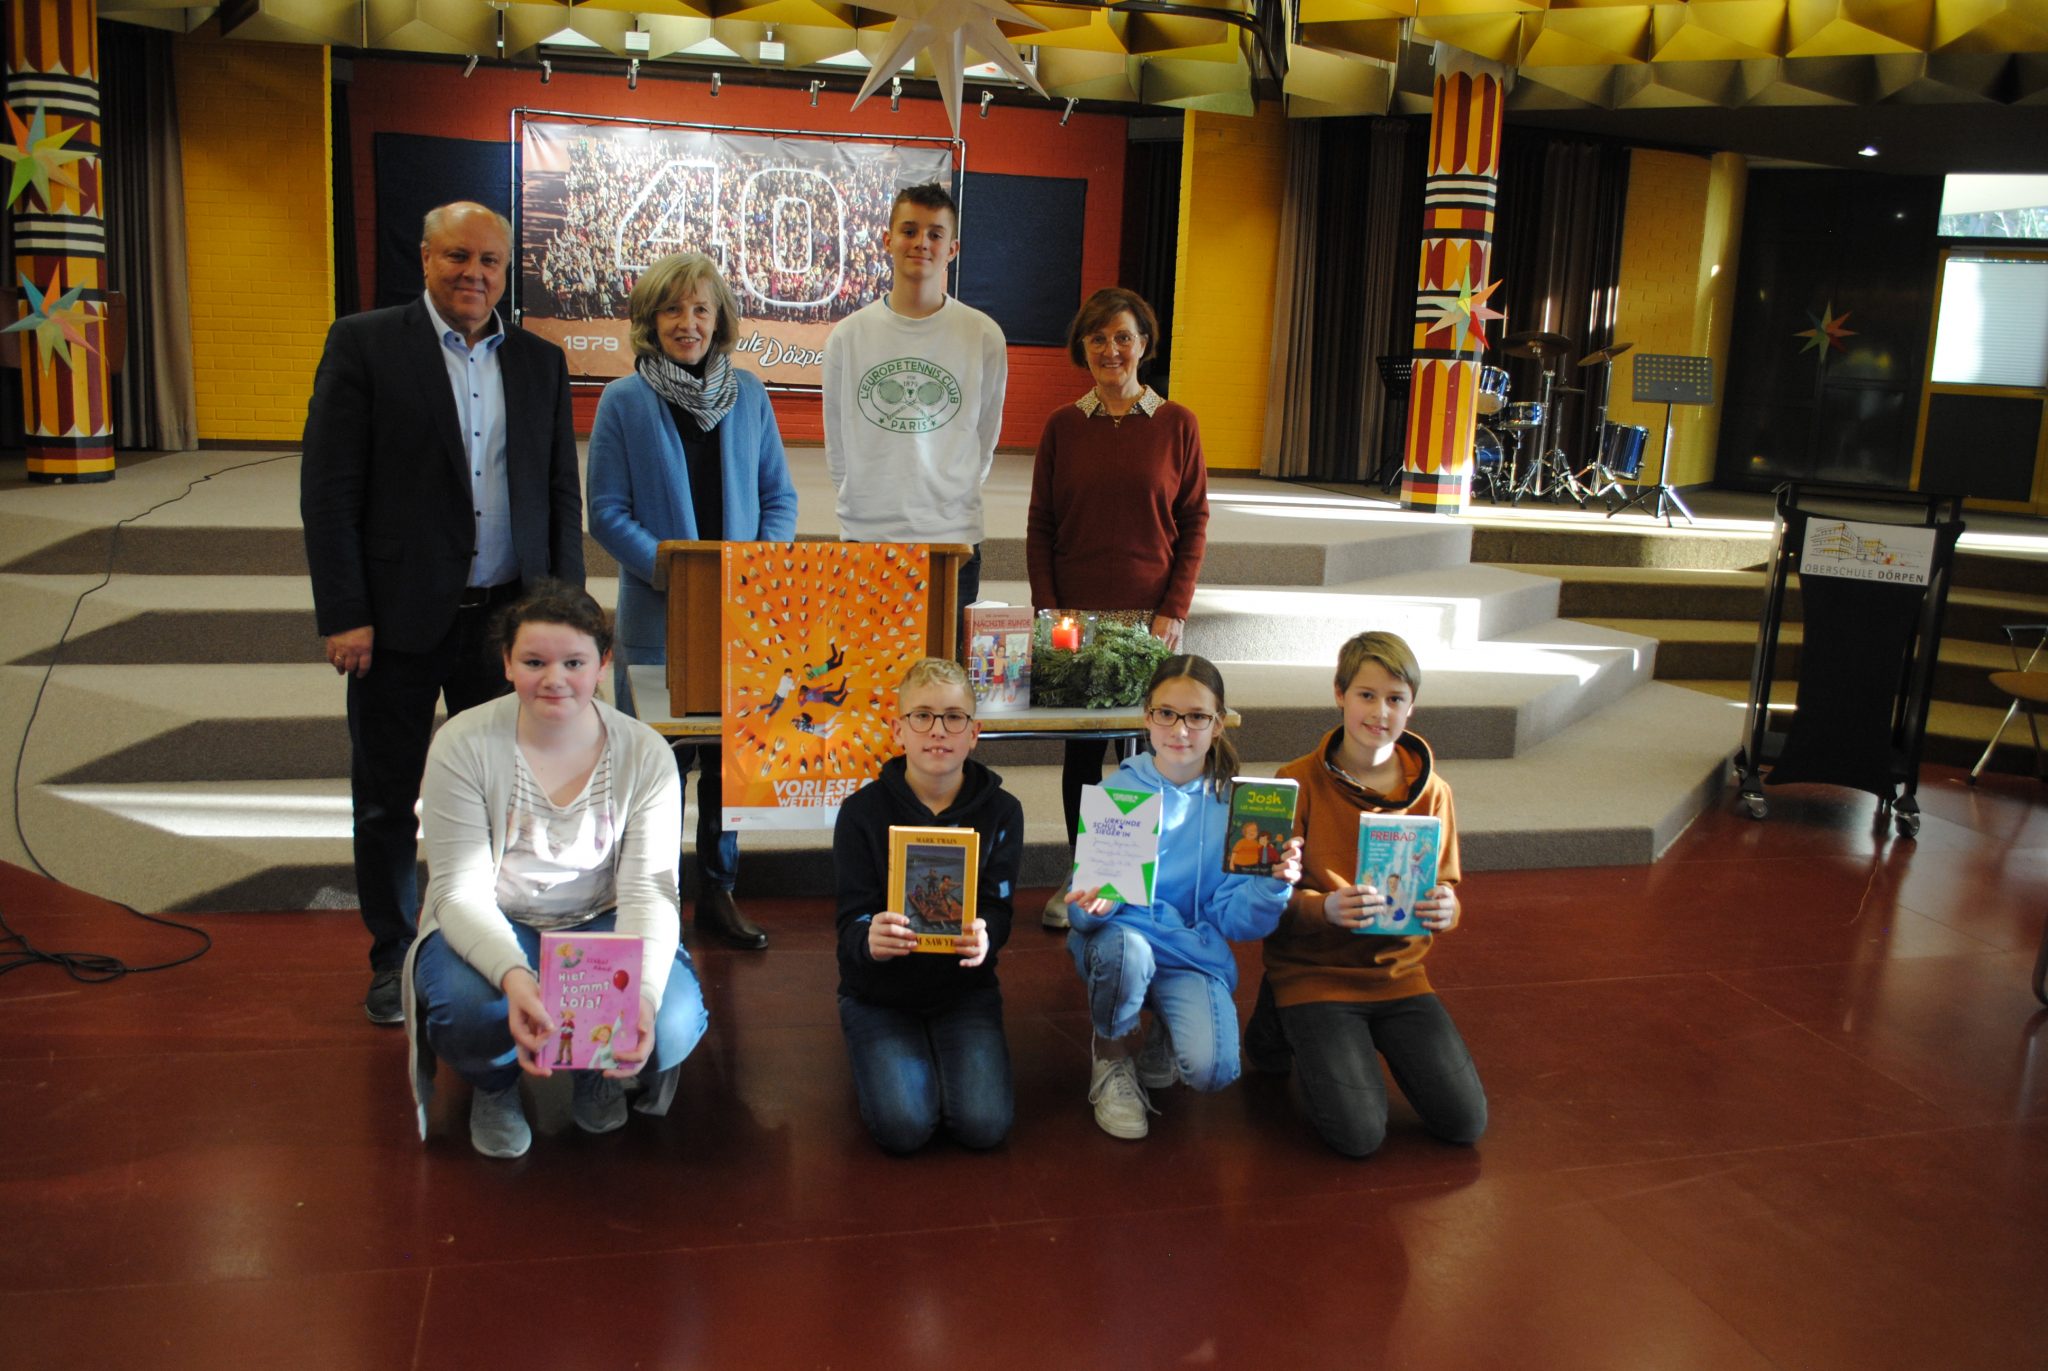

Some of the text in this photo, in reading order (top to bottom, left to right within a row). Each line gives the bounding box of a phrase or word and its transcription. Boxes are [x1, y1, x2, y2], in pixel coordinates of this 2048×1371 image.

[616, 160, 845, 308] 40
[563, 335, 619, 351] 1979
[860, 360, 959, 404] L'EUROPE TENNIS CLUB
[891, 420, 927, 431] PARIS
[1804, 563, 1925, 583] OBERSCHULE DÖRPEN
[773, 778, 858, 797] VORLESE
[778, 796, 847, 808] WETTBEW
[1247, 790, 1282, 805] Josh
[1105, 817, 1142, 828] URKUNDE
[1370, 830, 1417, 842] FREIBAD
[560, 995, 603, 1009] Lola!
